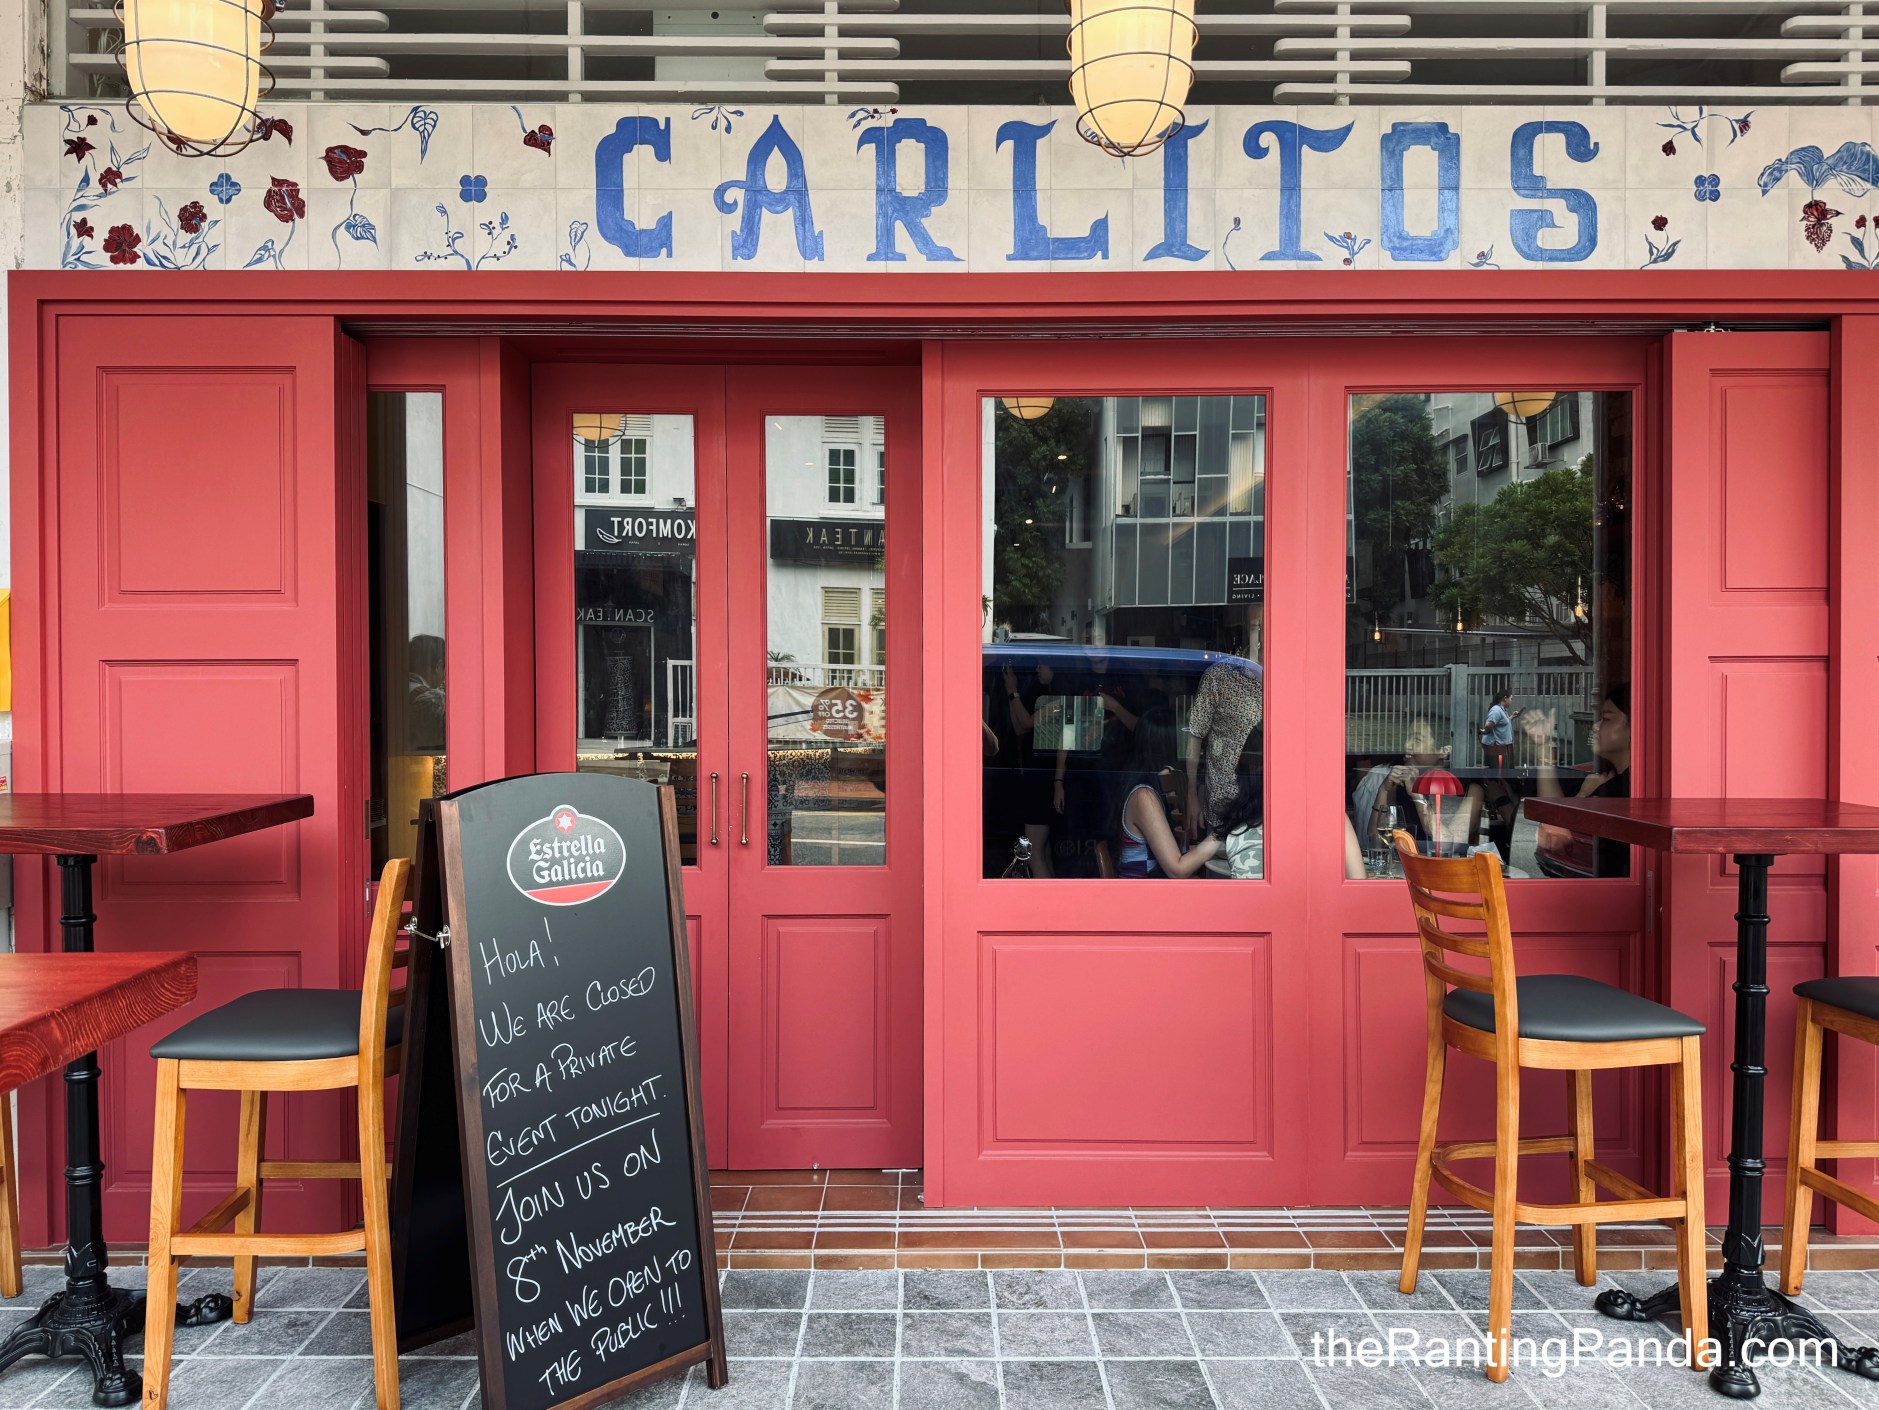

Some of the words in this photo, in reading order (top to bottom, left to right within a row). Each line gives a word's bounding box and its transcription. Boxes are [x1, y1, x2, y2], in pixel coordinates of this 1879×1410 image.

[595, 114, 1600, 262] CARLITOS
[528, 834, 606, 861] Estrella
[532, 856, 605, 883] Galicia
[479, 1002, 527, 1047] WE
[537, 995, 575, 1030] ARE
[586, 966, 656, 1011] CLOSED
[483, 1067, 531, 1108] FOR
[535, 1062, 553, 1092] A
[551, 1035, 637, 1080] PRIVATE
[487, 1114, 557, 1166] EVENT
[496, 1182, 564, 1245] JOIN
[575, 1162, 610, 1200] US
[623, 1129, 661, 1176] ON
[556, 1206, 677, 1274] NOVEMBER
[506, 1316, 563, 1362] WHEN
[566, 1285, 602, 1326] WE
[608, 1256, 661, 1307] OPEN
[666, 1249, 692, 1284] TO
[538, 1350, 582, 1396] THE
